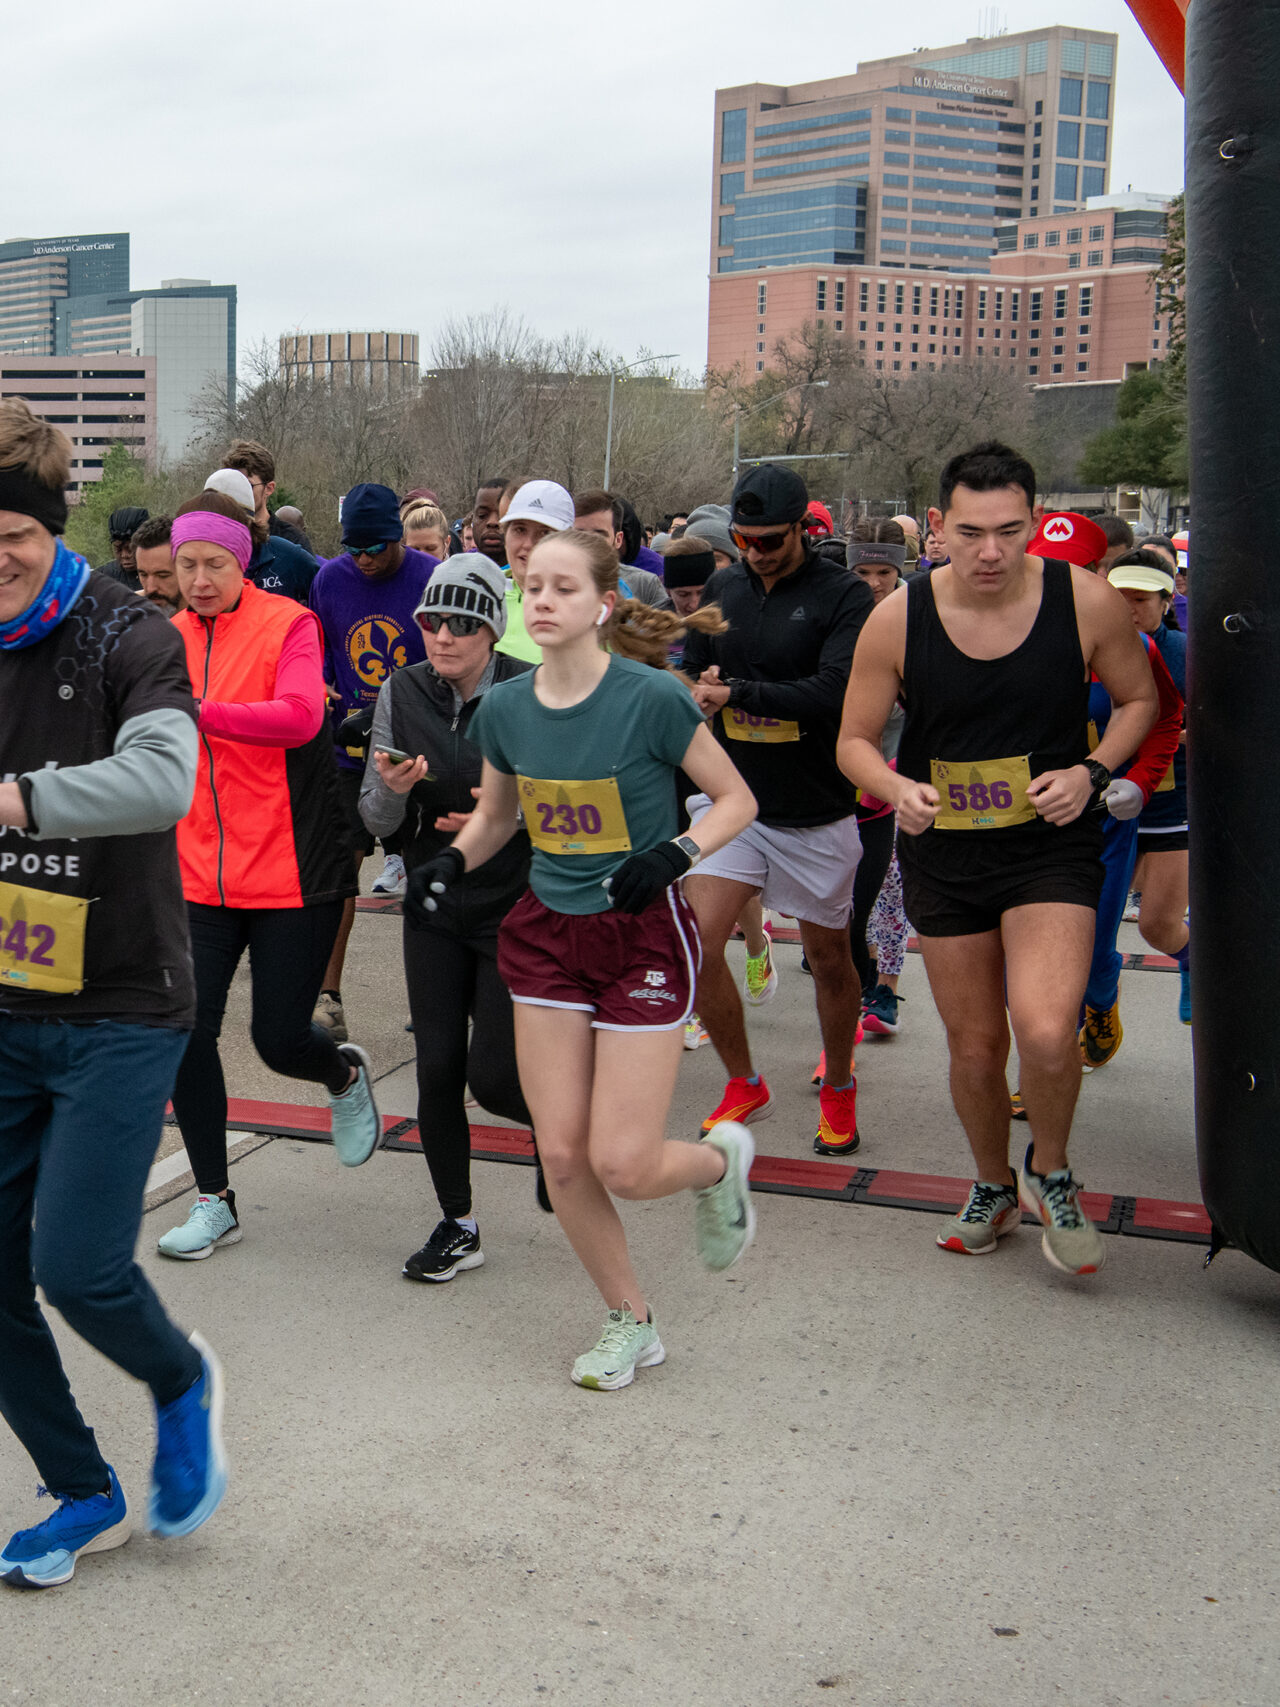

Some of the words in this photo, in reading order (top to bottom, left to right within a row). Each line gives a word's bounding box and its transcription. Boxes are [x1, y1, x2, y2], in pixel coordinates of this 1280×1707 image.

[932, 79, 963, 93] Anderson
[964, 83, 986, 96] Cancer
[987, 86, 1008, 98] Center
[44, 245, 71, 254] Anderson
[72, 244, 94, 252] Cancer
[94, 242, 115, 250] Center
[262, 576, 283, 588] ICA
[422, 584, 494, 621] UMA
[948, 780, 1013, 811] 586
[536, 802, 602, 836] 230
